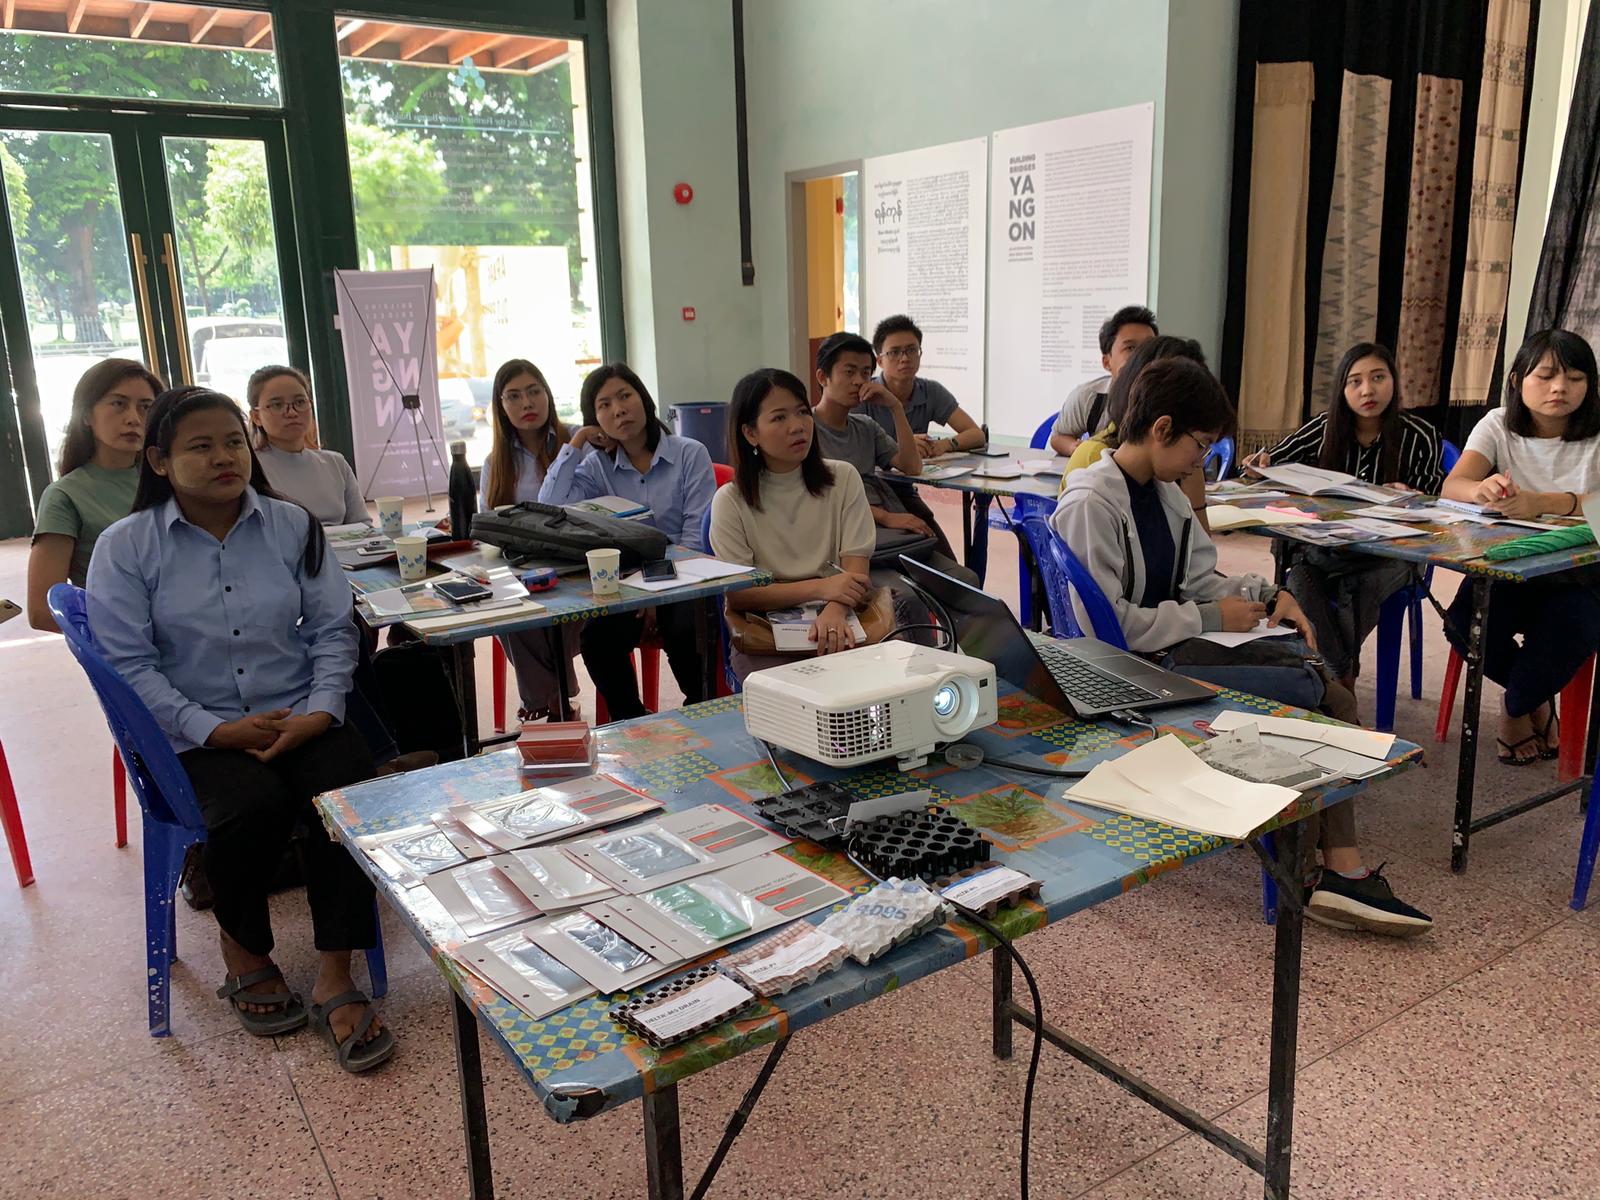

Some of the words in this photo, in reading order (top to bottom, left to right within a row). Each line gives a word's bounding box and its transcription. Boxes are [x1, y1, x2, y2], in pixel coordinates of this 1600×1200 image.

[1009, 154, 1036, 165] BUILDING
[1009, 163, 1036, 174] BRIDGES
[1009, 174, 1035, 196] YA
[874, 199, 903, 225] ရန်ကုန်
[1009, 197, 1035, 220] NG
[1008, 220, 1036, 242] ON
[678, 997, 702, 1012] DRAIN
